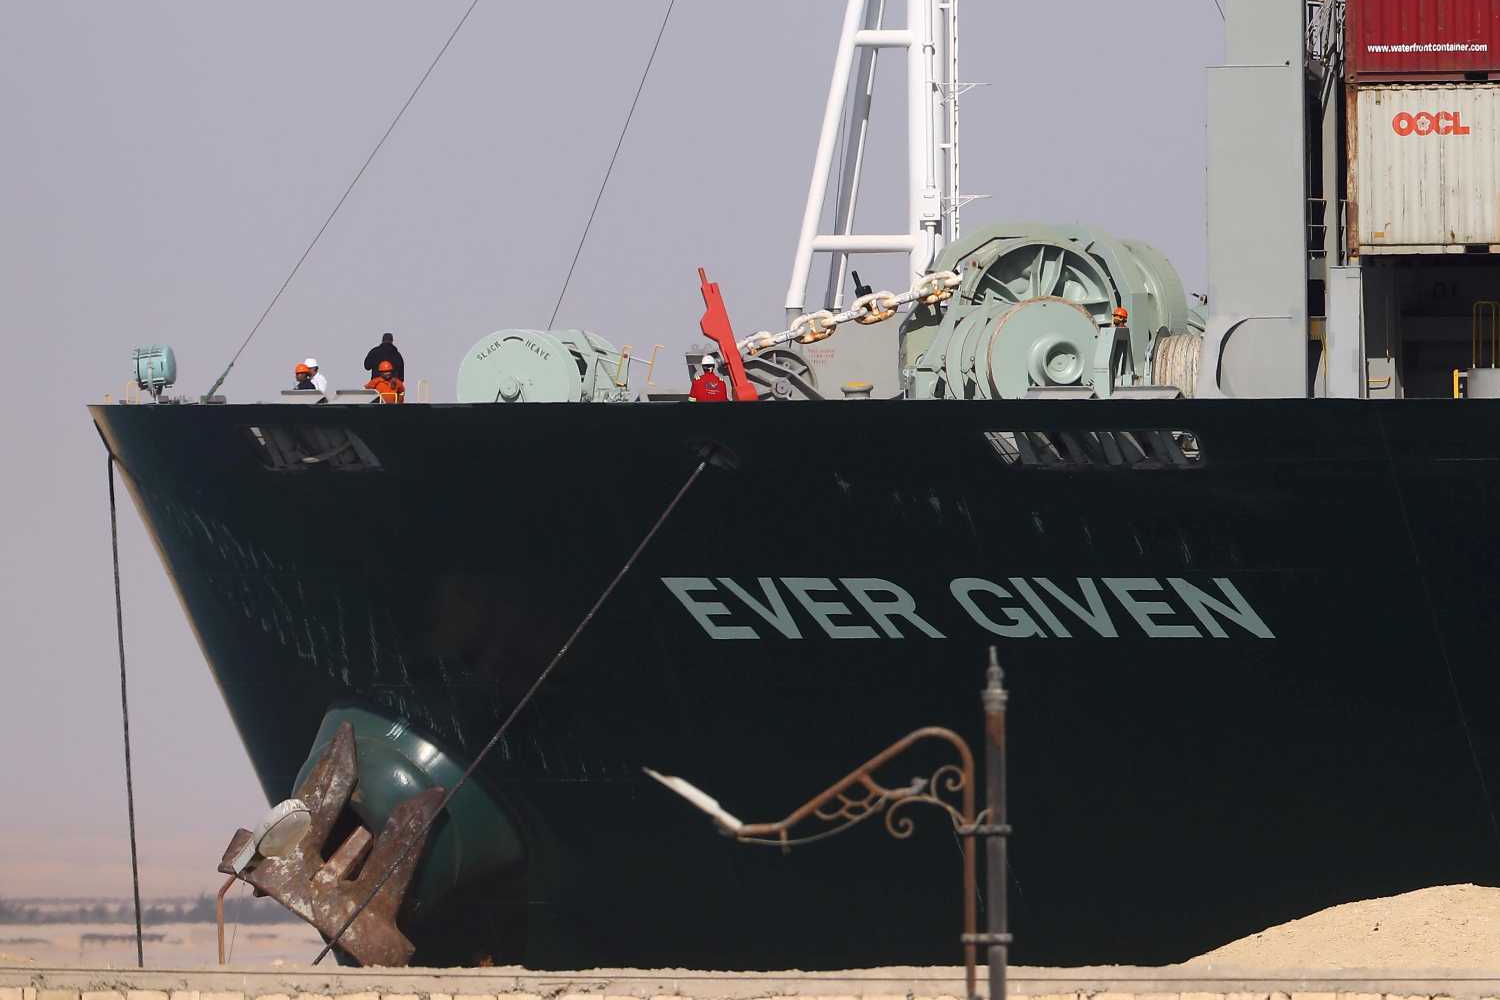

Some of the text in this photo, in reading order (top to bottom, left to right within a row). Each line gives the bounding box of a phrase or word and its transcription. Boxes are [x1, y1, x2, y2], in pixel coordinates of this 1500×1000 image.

[1367, 43, 1488, 53] www.waterfrontcontainer.com
[1392, 111, 1470, 136] OOCL
[661, 577, 1276, 640] EVER GIVEN
